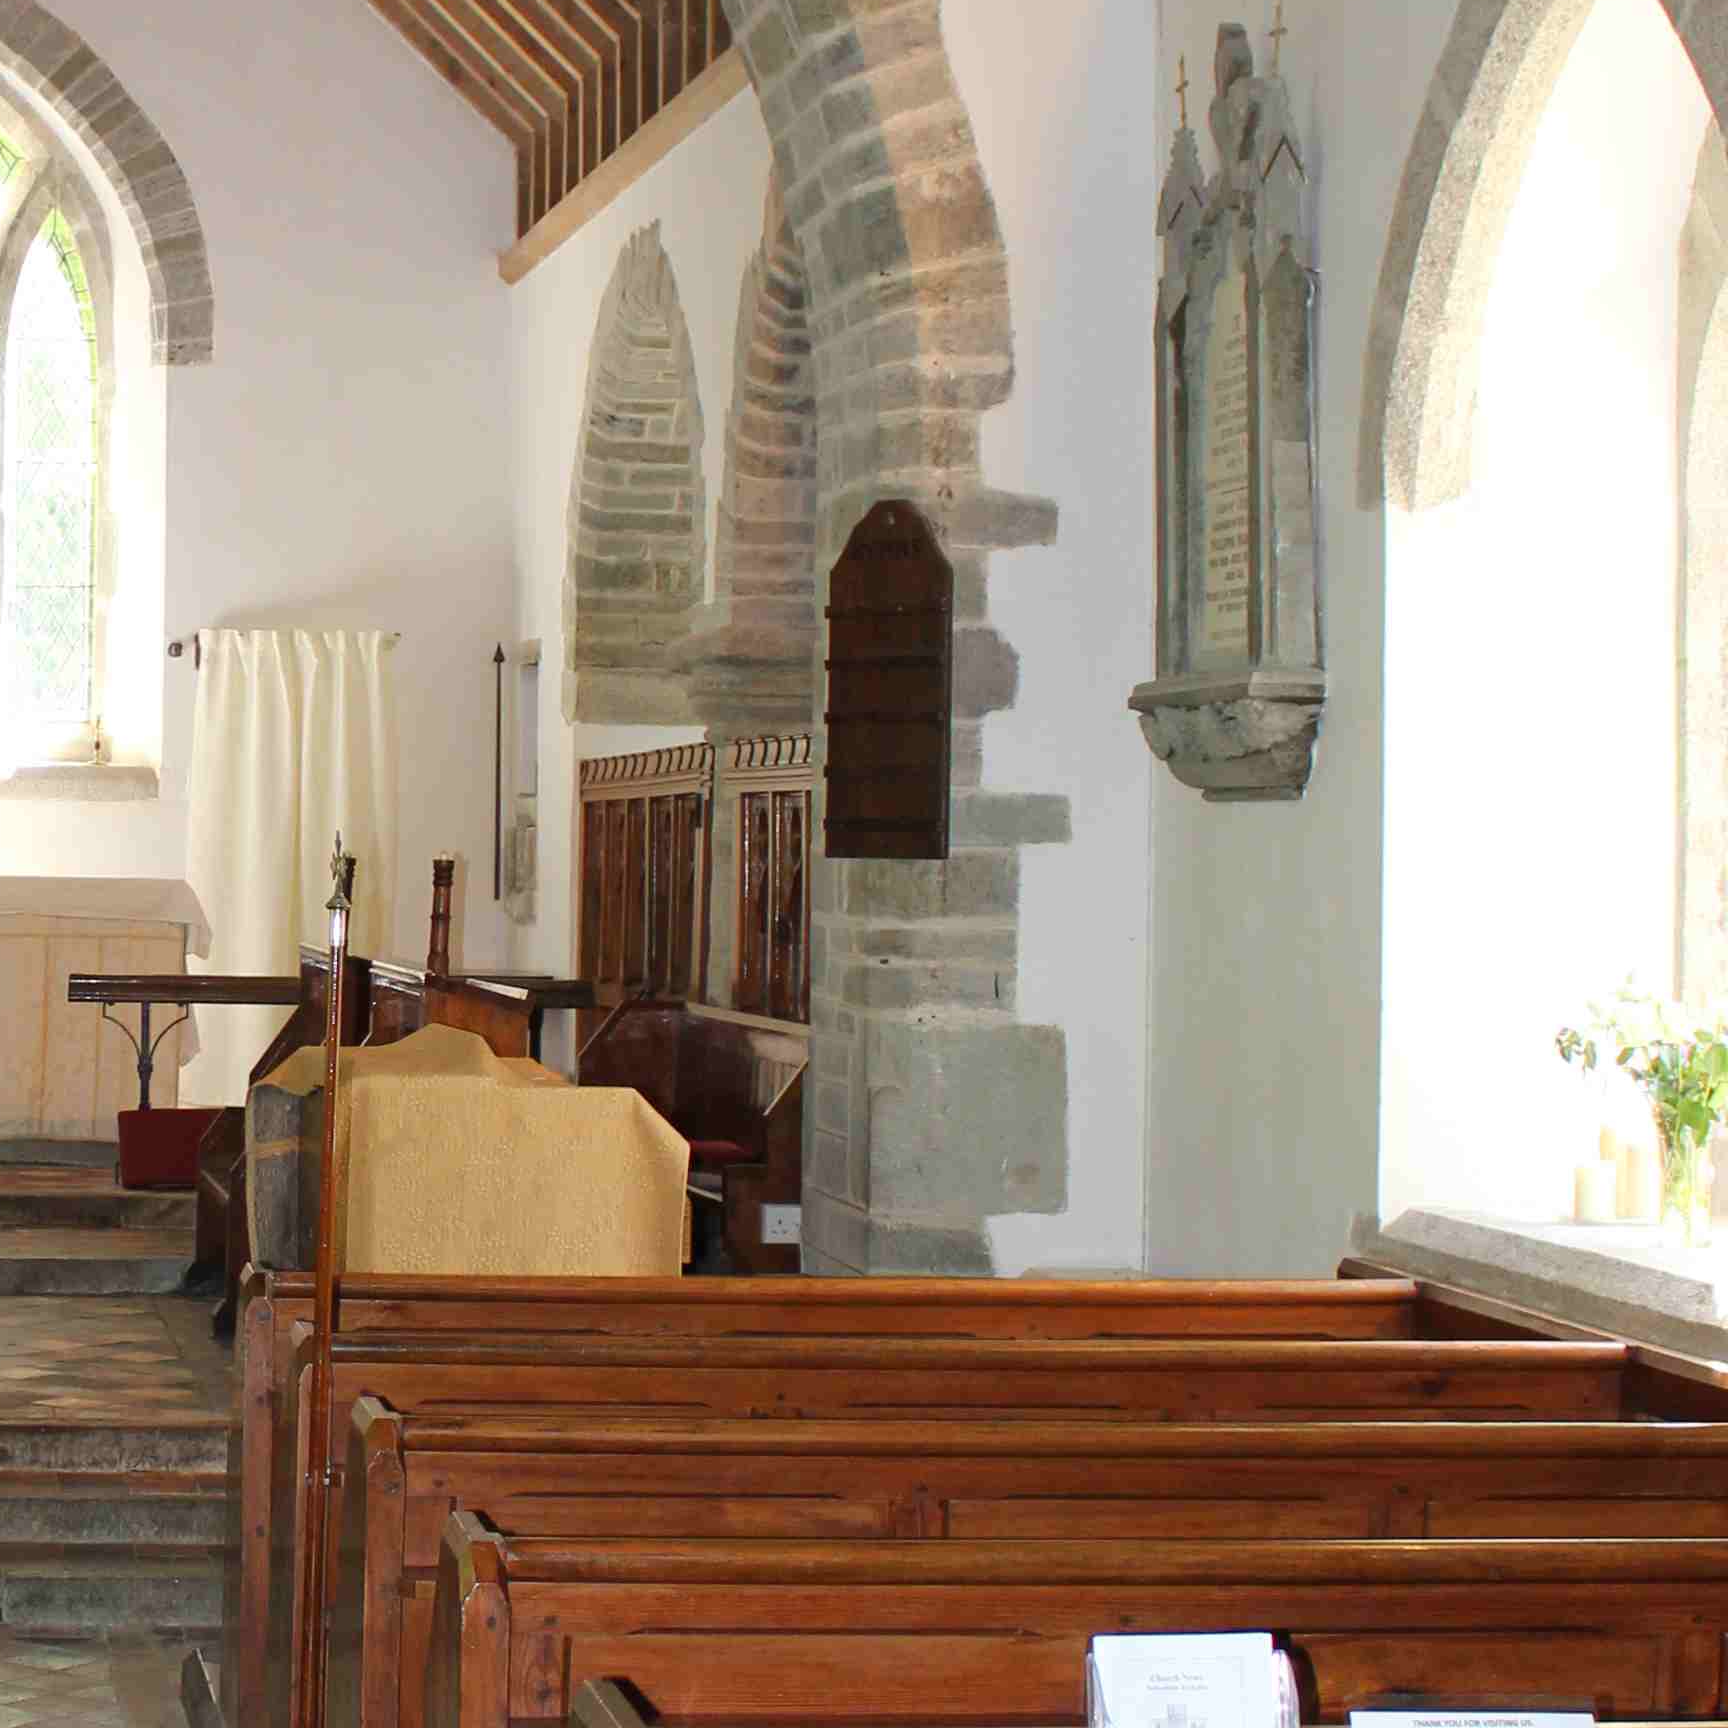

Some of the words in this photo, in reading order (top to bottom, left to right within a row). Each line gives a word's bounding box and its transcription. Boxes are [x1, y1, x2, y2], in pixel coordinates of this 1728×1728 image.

[1413, 1719, 1442, 1728] THANK
[1444, 1719, 1462, 1728] YOU
[1464, 1719, 1481, 1728] FOR
[1483, 1719, 1519, 1728] VISITING
